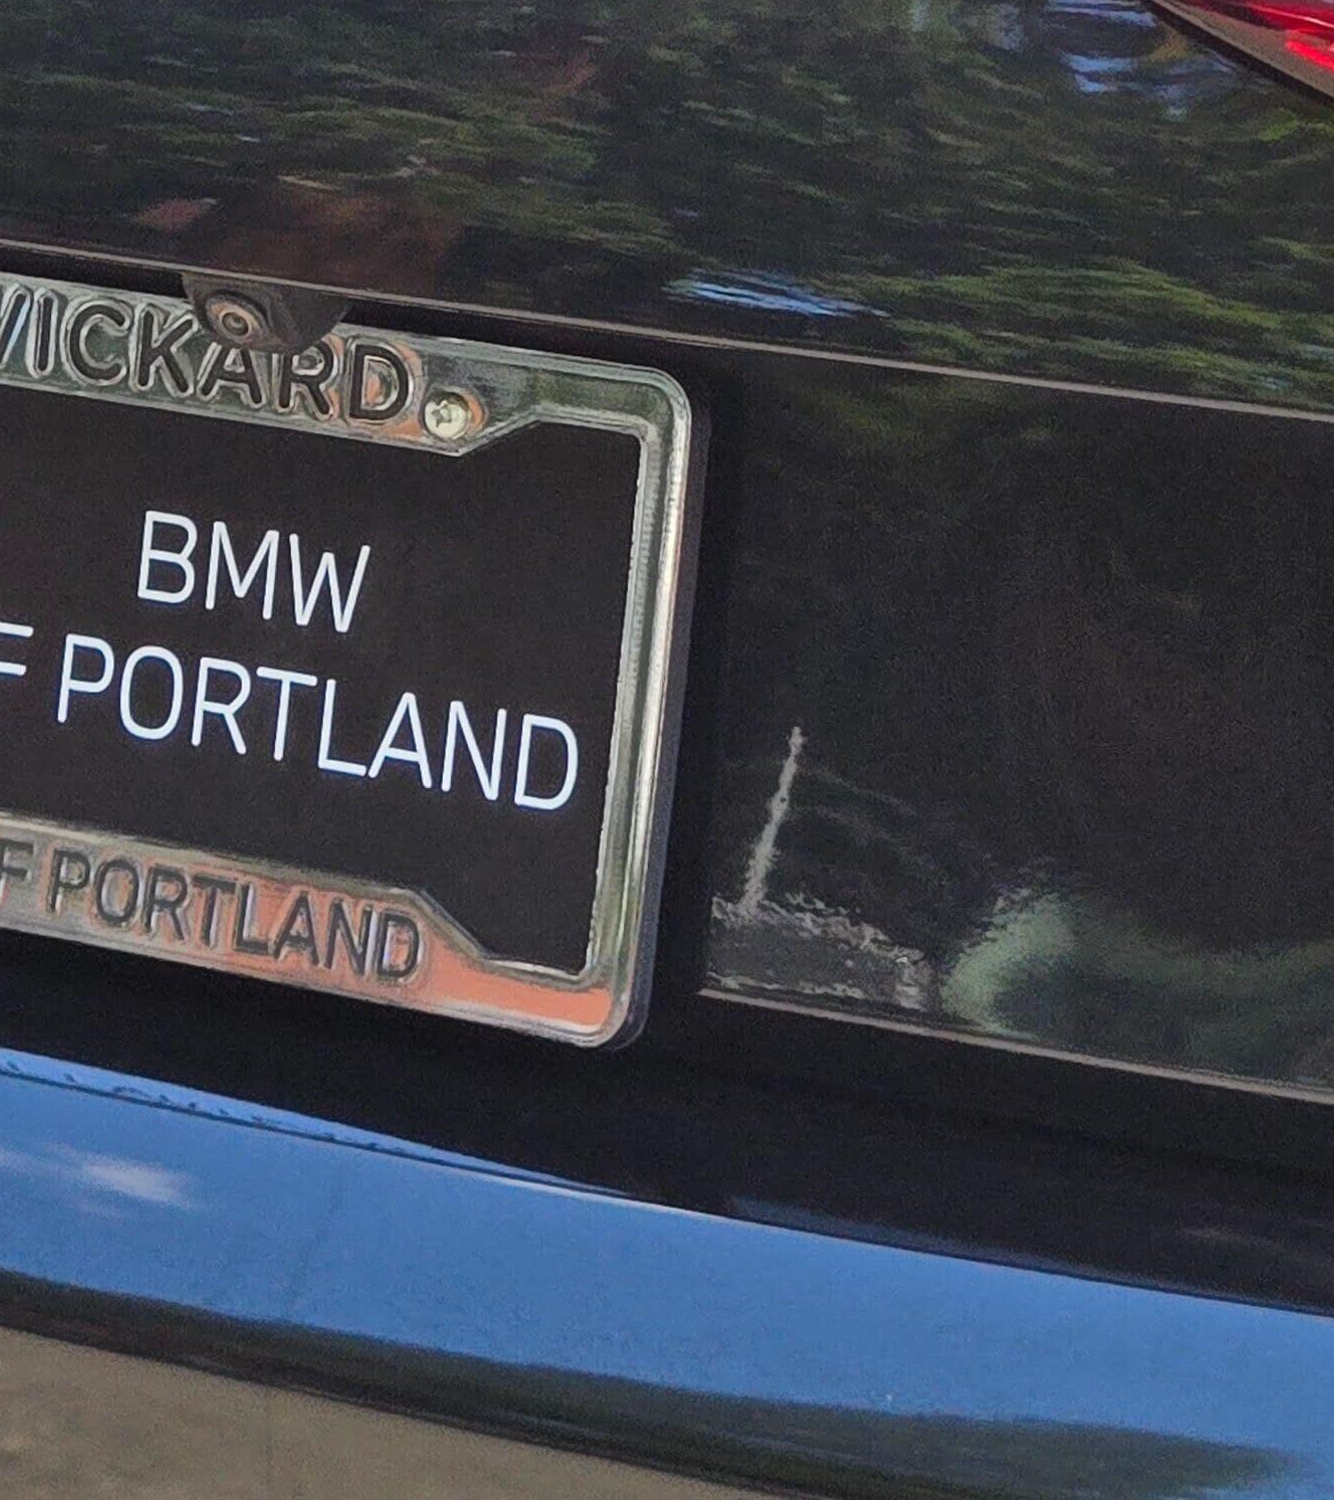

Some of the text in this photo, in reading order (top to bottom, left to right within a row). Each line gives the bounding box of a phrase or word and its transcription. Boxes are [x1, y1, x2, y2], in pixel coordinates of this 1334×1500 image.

[136, 510, 371, 633] BMW
[56, 633, 579, 811] PORTLAND
[47, 848, 424, 982] PORTLAND
